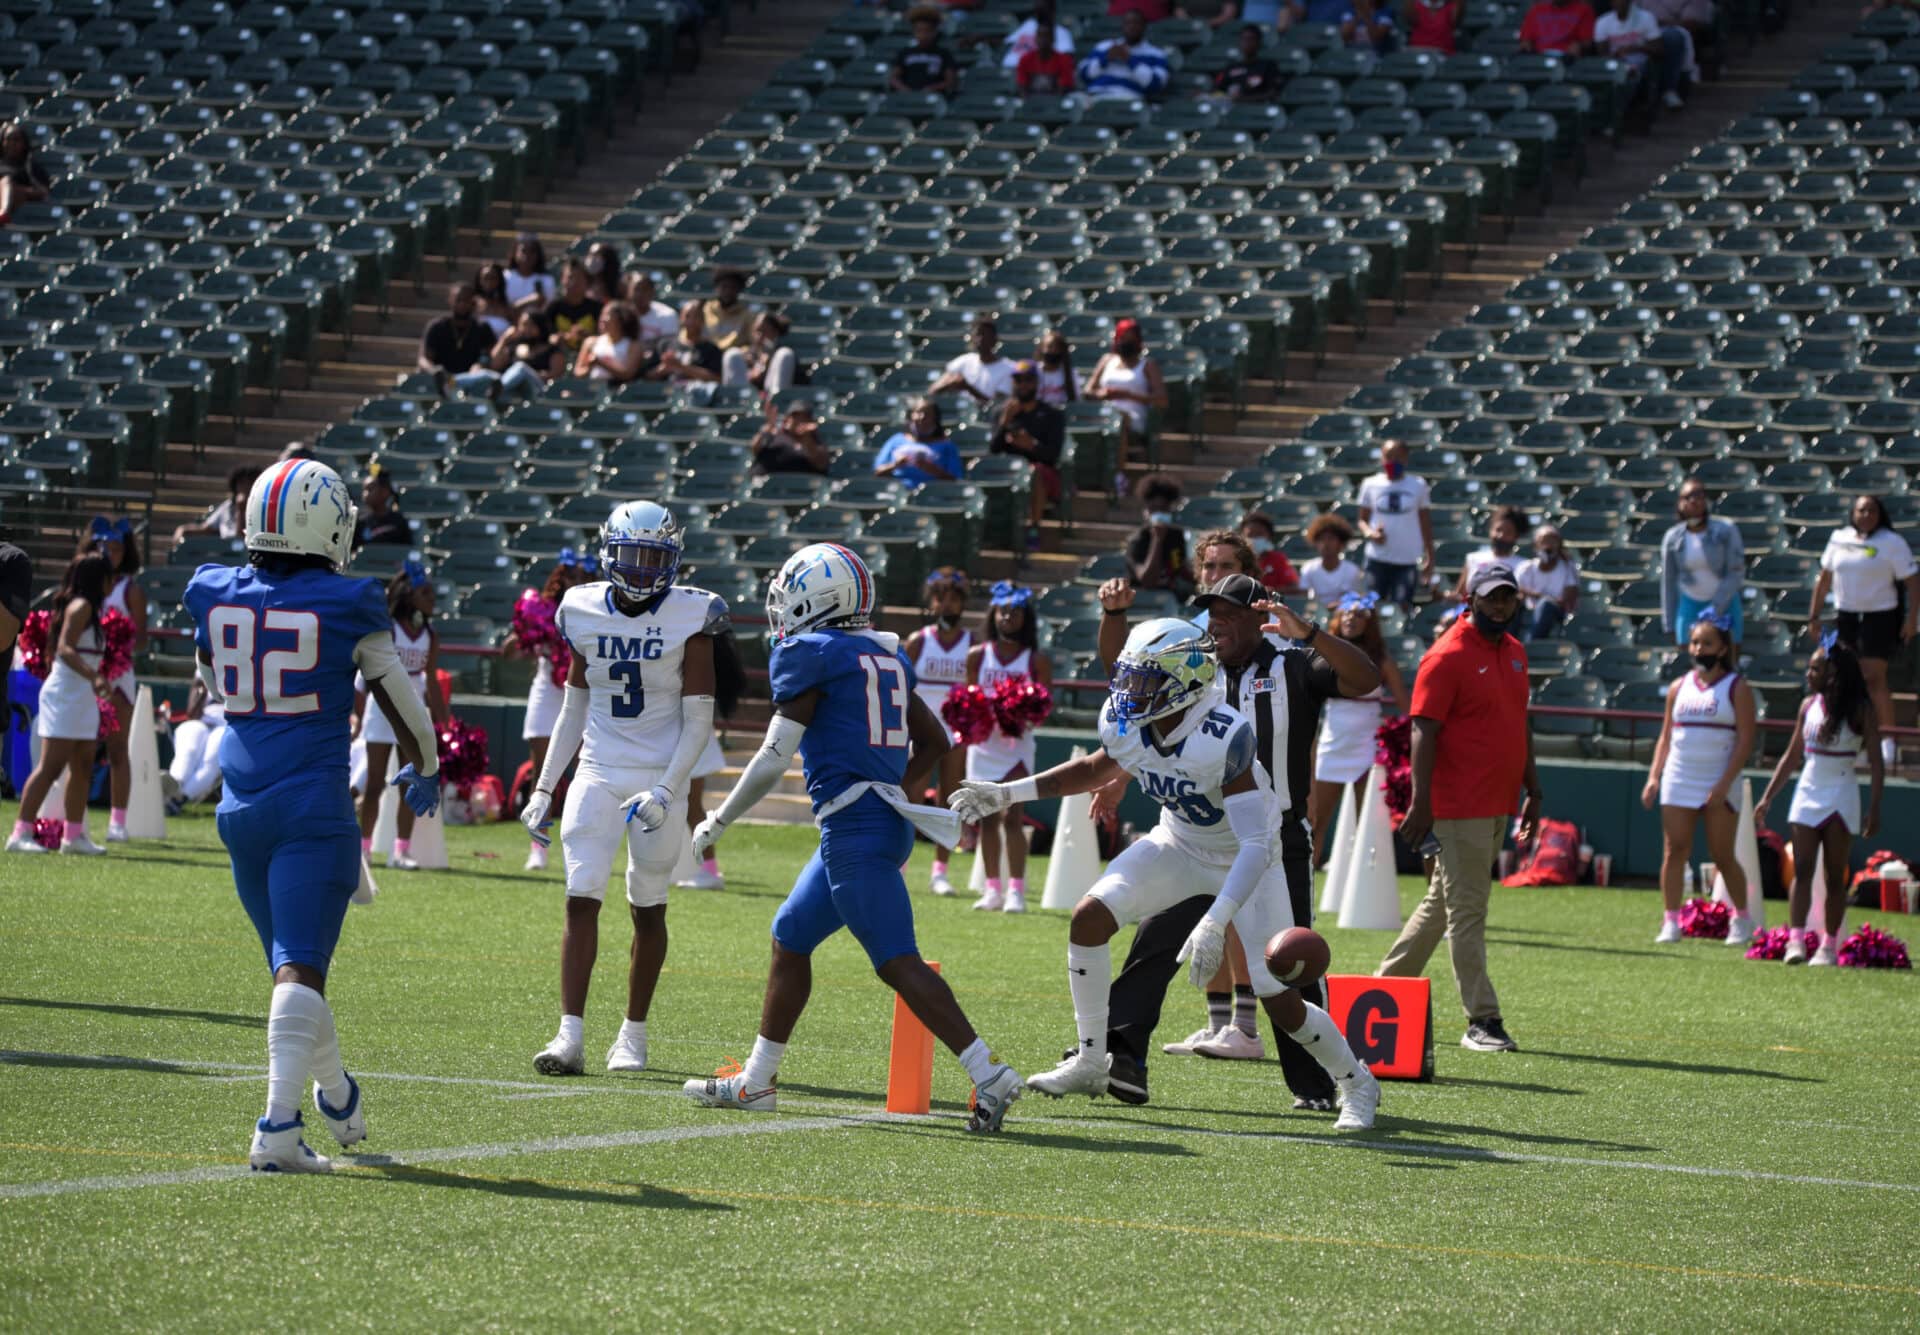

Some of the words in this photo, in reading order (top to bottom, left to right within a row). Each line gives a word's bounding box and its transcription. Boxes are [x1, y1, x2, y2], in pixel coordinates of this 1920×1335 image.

[209, 605, 320, 714] 82
[597, 635, 664, 661] IMG
[608, 661, 645, 718] 3
[859, 653, 909, 747] 13
[1202, 709, 1234, 739] 20
[1346, 988, 1400, 1067] G
